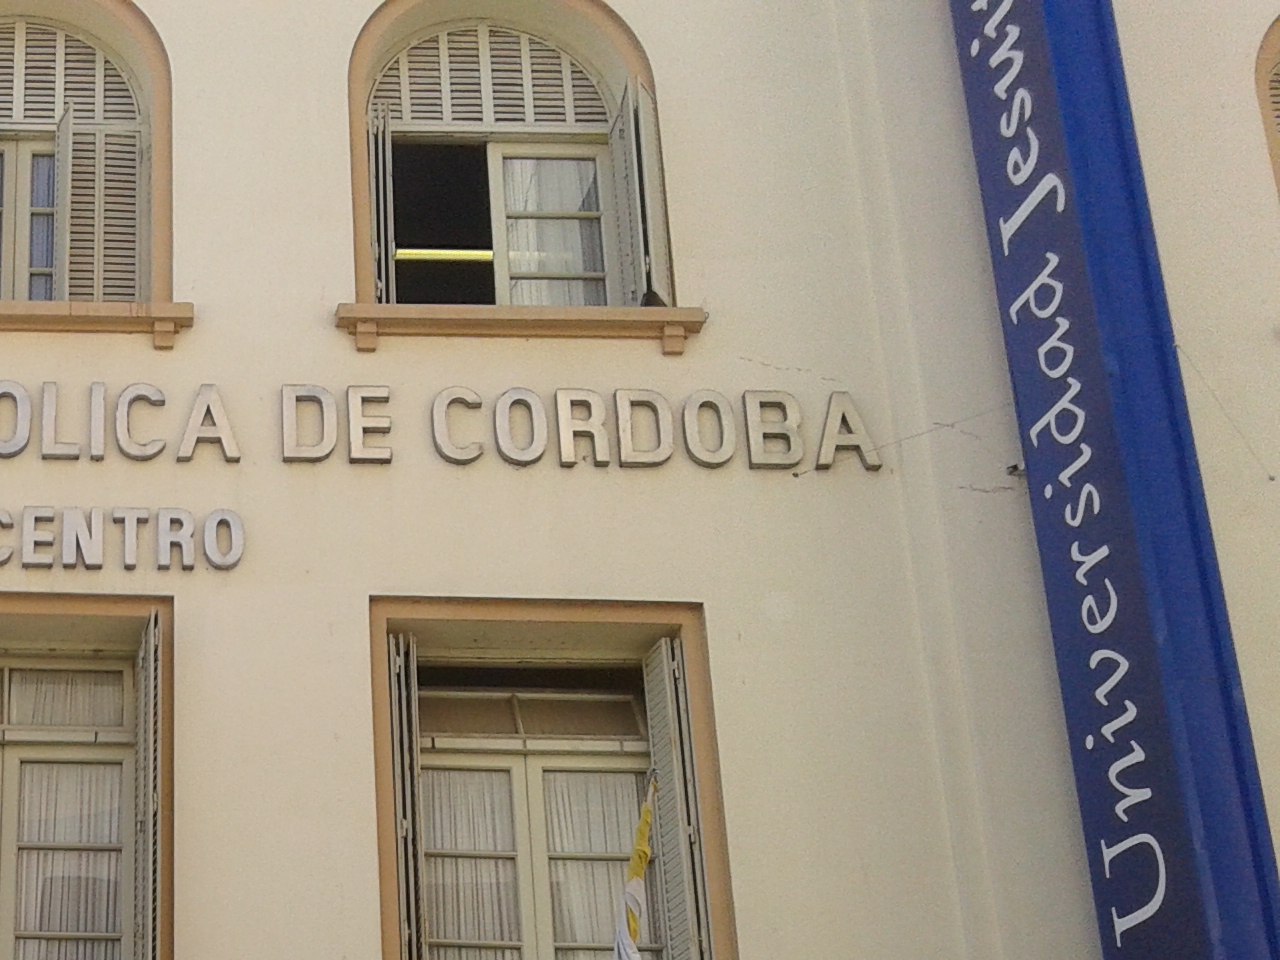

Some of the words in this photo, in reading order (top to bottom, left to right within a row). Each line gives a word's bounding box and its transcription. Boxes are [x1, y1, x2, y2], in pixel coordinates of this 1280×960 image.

[281, 383, 394, 465] DE
[432, 386, 883, 472] CORDOBA
[1009, 252, 1167, 947] Universidad
